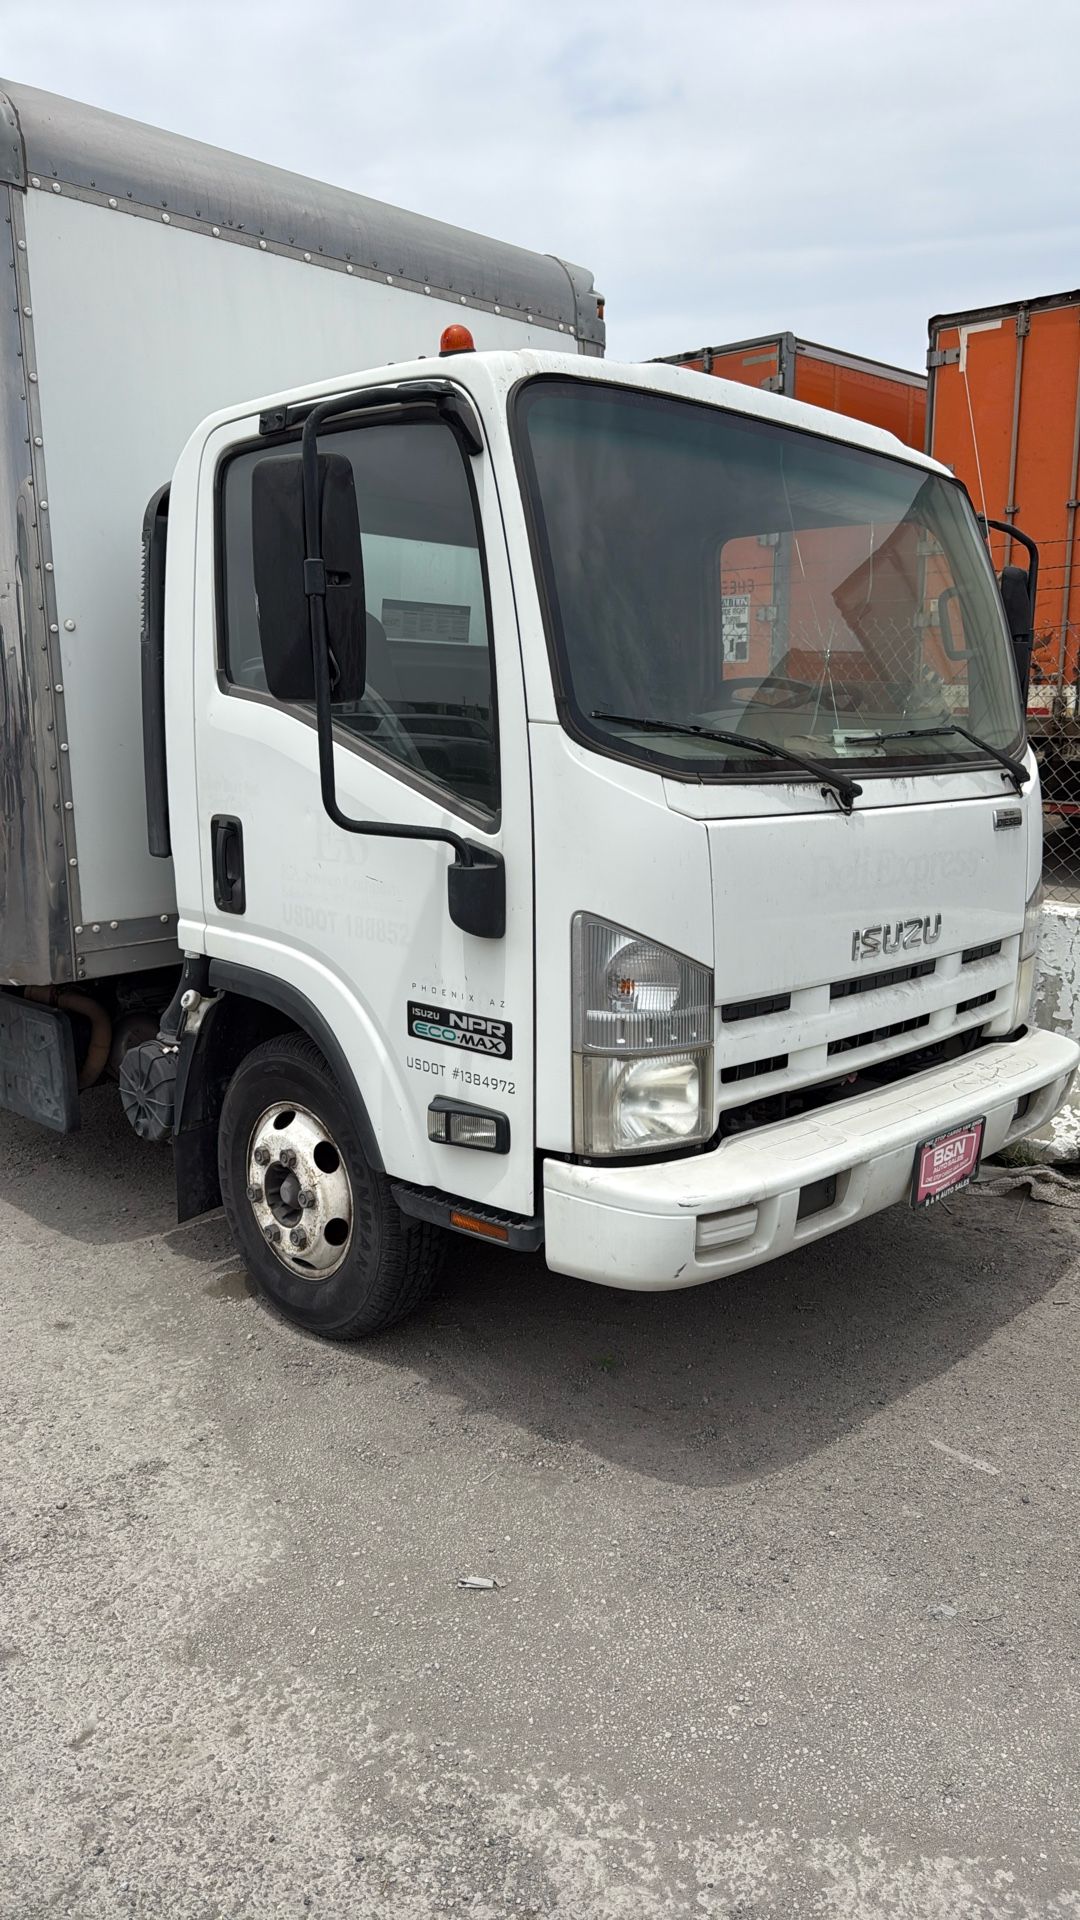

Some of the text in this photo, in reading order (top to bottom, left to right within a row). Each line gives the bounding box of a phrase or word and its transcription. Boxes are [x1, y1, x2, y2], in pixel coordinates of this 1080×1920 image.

[721, 598, 748, 607] AUTION
[851, 912, 942, 961] ISUZU
[411, 982, 506, 1009] PHOENIX AZ
[412, 1007, 506, 1038] ISUZU NPR
[406, 1056, 516, 1095] USDOT #1384972
[933, 1138, 966, 1167] B&N
[933, 1162, 948, 1174] AUTO
[940, 1186, 954, 1199] AUTO
[954, 1177, 970, 1191] SALES
